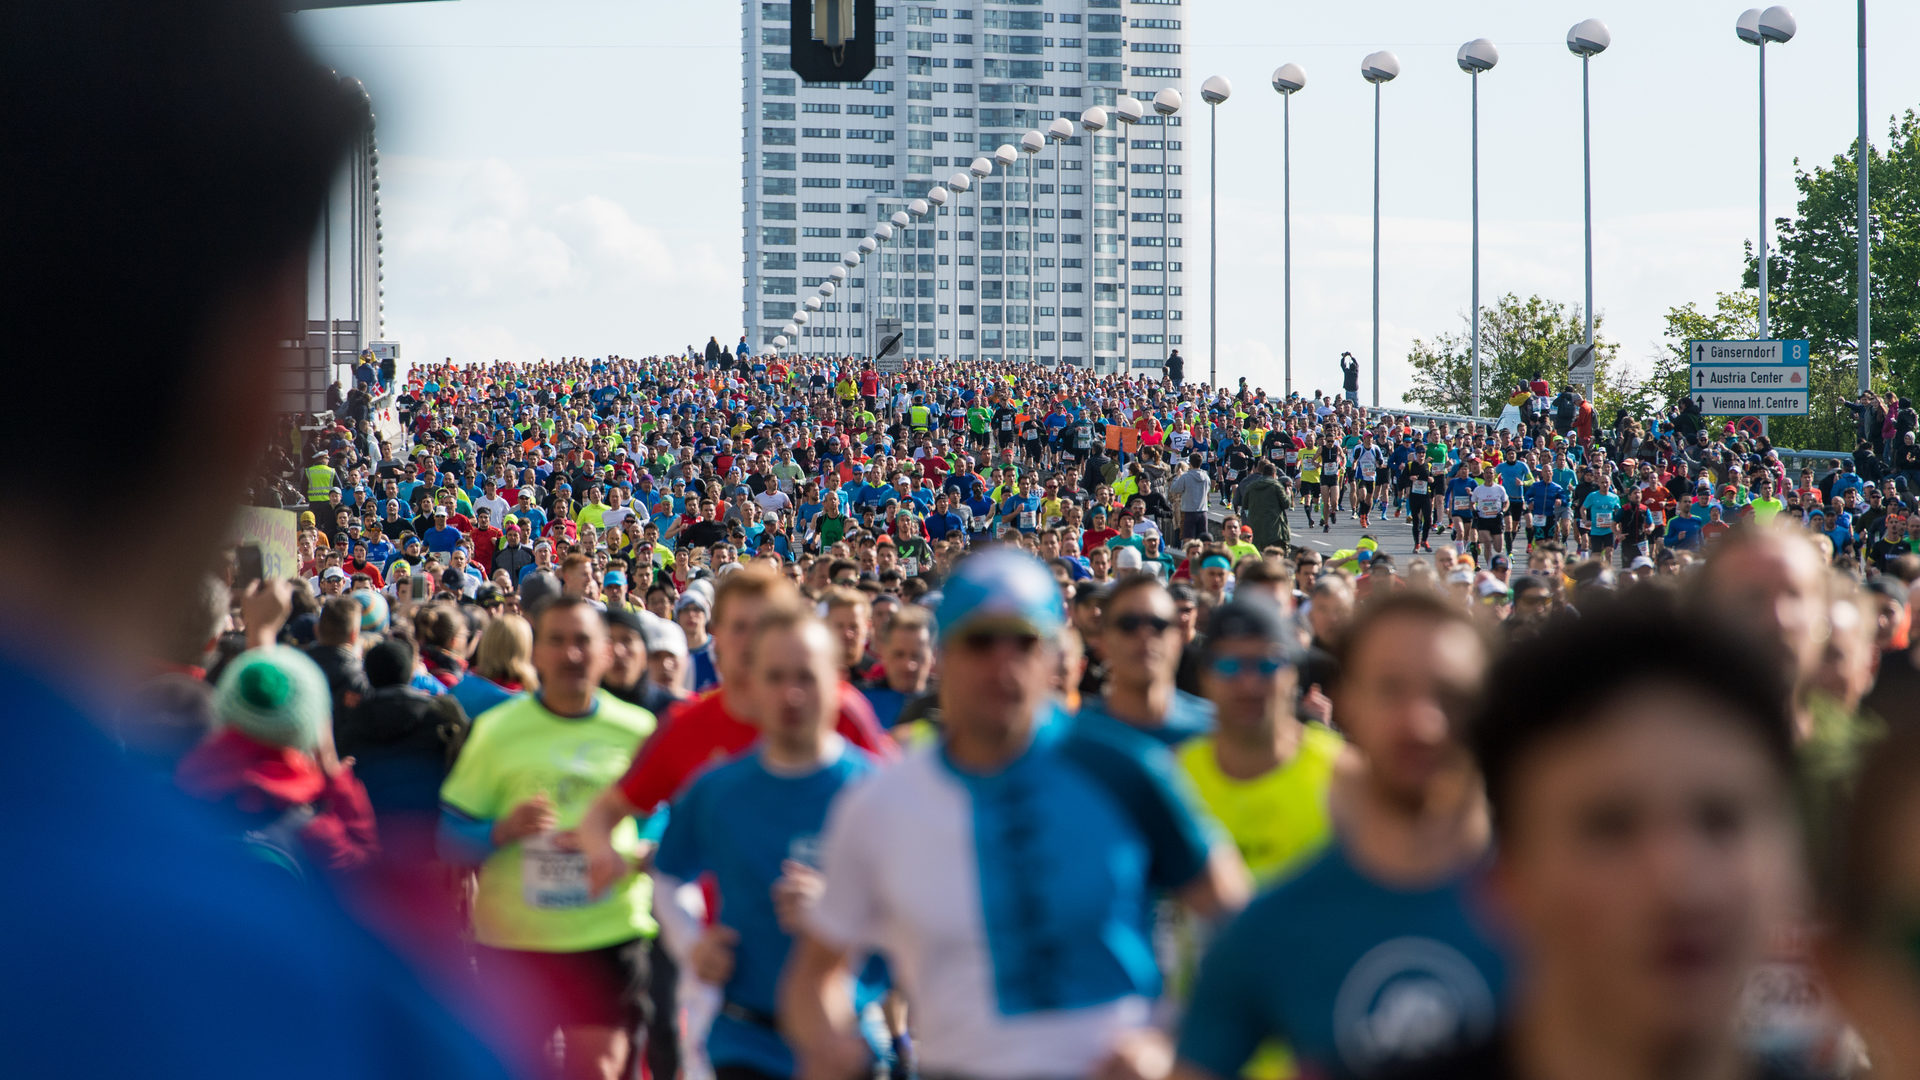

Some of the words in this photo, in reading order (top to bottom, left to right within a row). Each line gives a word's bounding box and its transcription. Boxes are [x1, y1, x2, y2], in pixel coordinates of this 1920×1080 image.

[1711, 346, 1775, 358] Gänserndorf
[1792, 345, 1801, 359] 8
[1710, 372, 1746, 383] Austria
[1751, 372, 1783, 383] Center
[1712, 397, 1746, 409] Vienna
[1748, 397, 1764, 409] Int.
[1766, 397, 1799, 409] Centre
